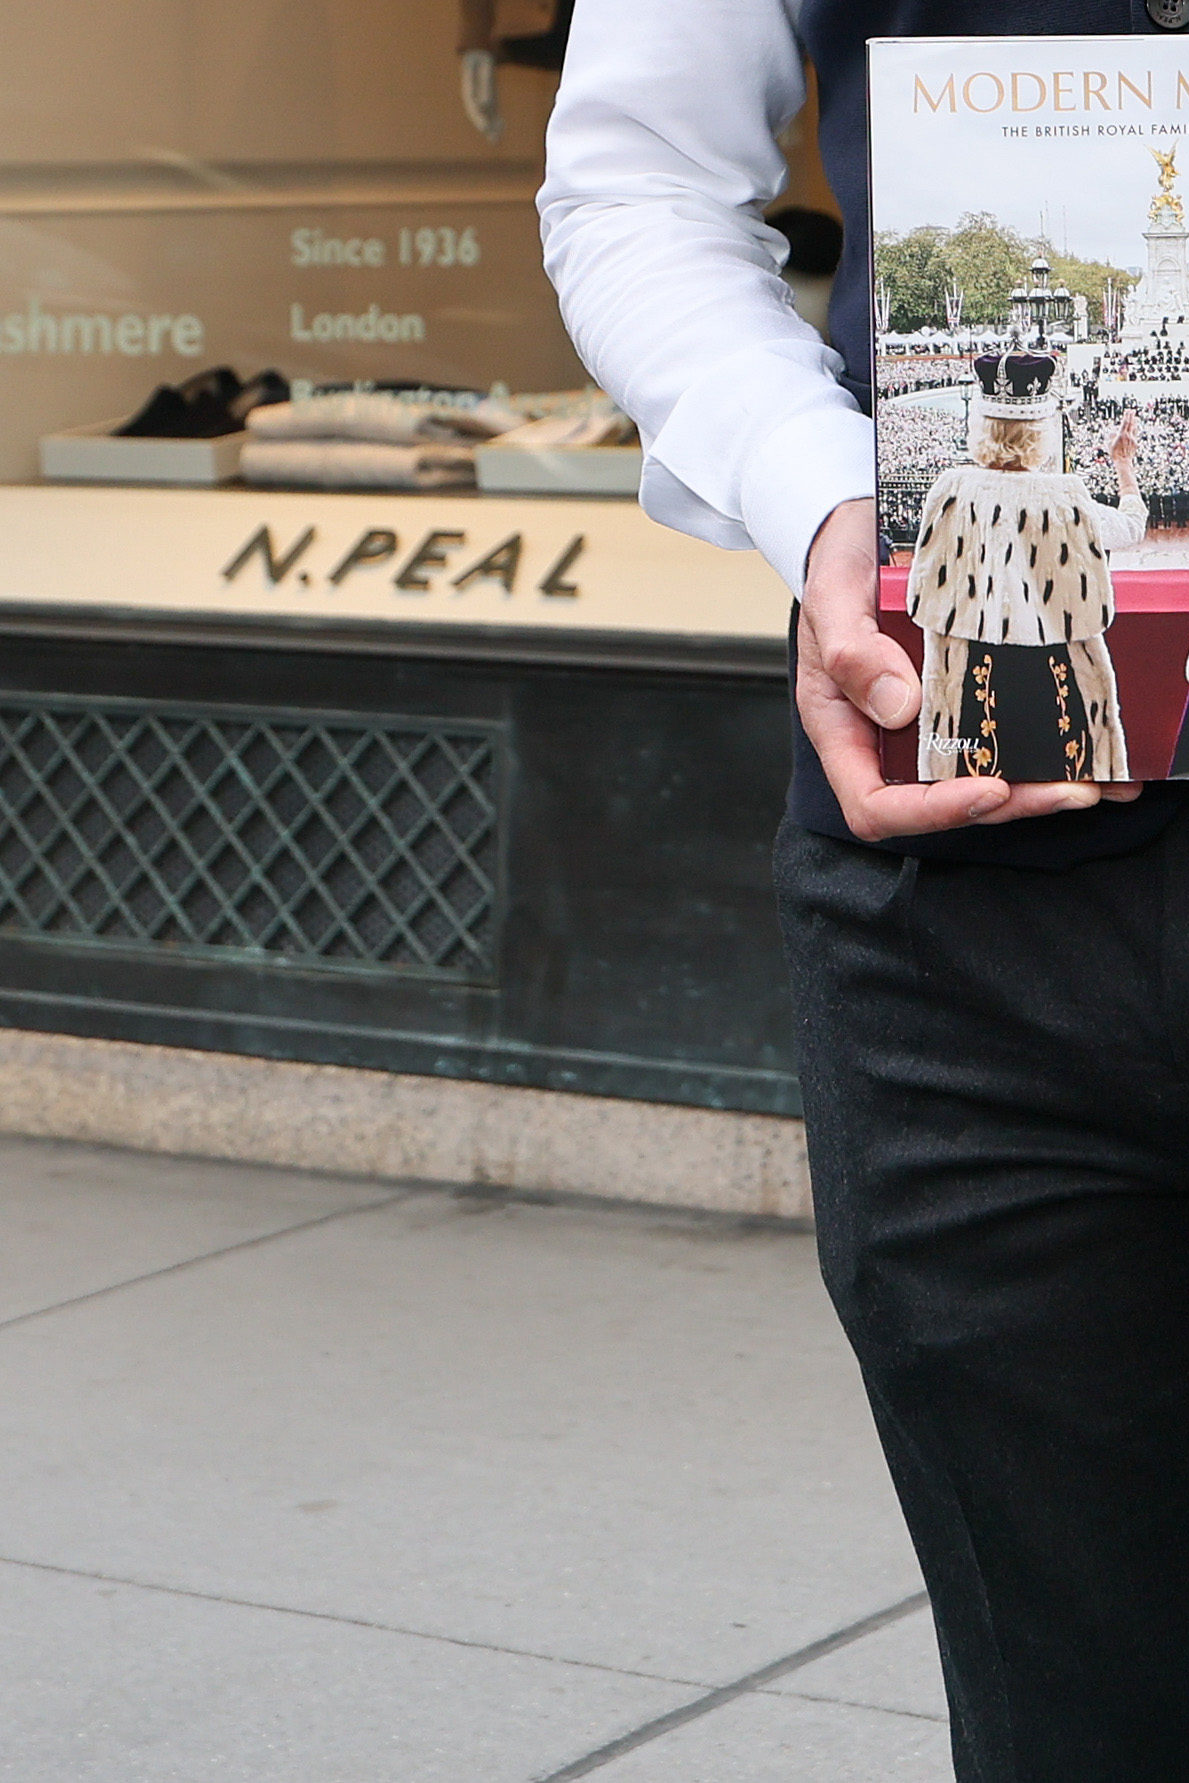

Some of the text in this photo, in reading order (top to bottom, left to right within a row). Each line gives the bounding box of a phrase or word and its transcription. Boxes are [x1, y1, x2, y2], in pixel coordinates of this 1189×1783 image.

[912, 69, 1153, 114] MODERN
[1002, 126, 1028, 138] THE
[1034, 124, 1091, 138] BRITISH
[1097, 123, 1145, 137] ROYAL
[290, 226, 481, 268] Since 1936
[289, 303, 426, 343] London
[221, 523, 588, 599] N.PEAL
